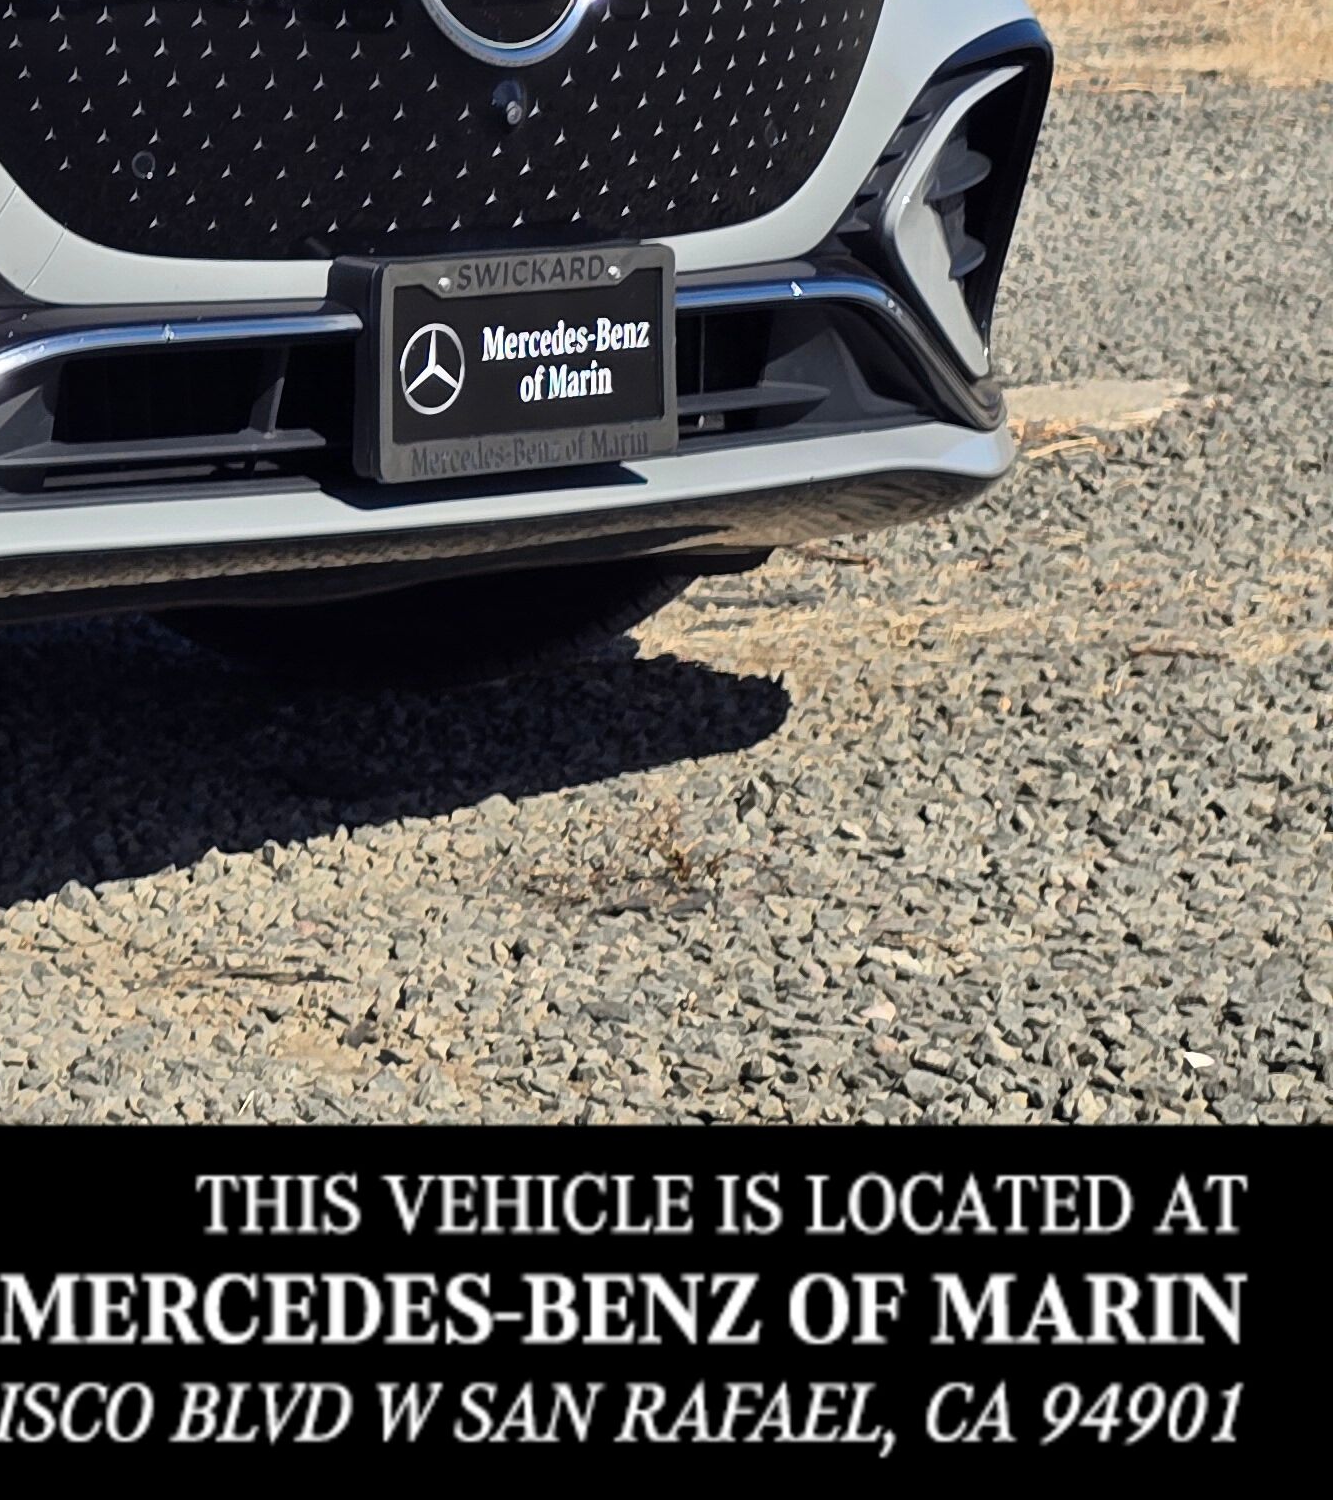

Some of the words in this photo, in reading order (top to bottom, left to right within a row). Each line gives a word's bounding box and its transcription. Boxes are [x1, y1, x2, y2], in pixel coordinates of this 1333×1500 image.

[455, 254, 606, 292] SWICKARD
[481, 316, 651, 363] Mercedes-Benz
[520, 365, 545, 403] of
[547, 358, 614, 401] Marin
[410, 437, 561, 478] Mercedes-Benz
[565, 431, 584, 458] of
[590, 428, 650, 460] Marin
